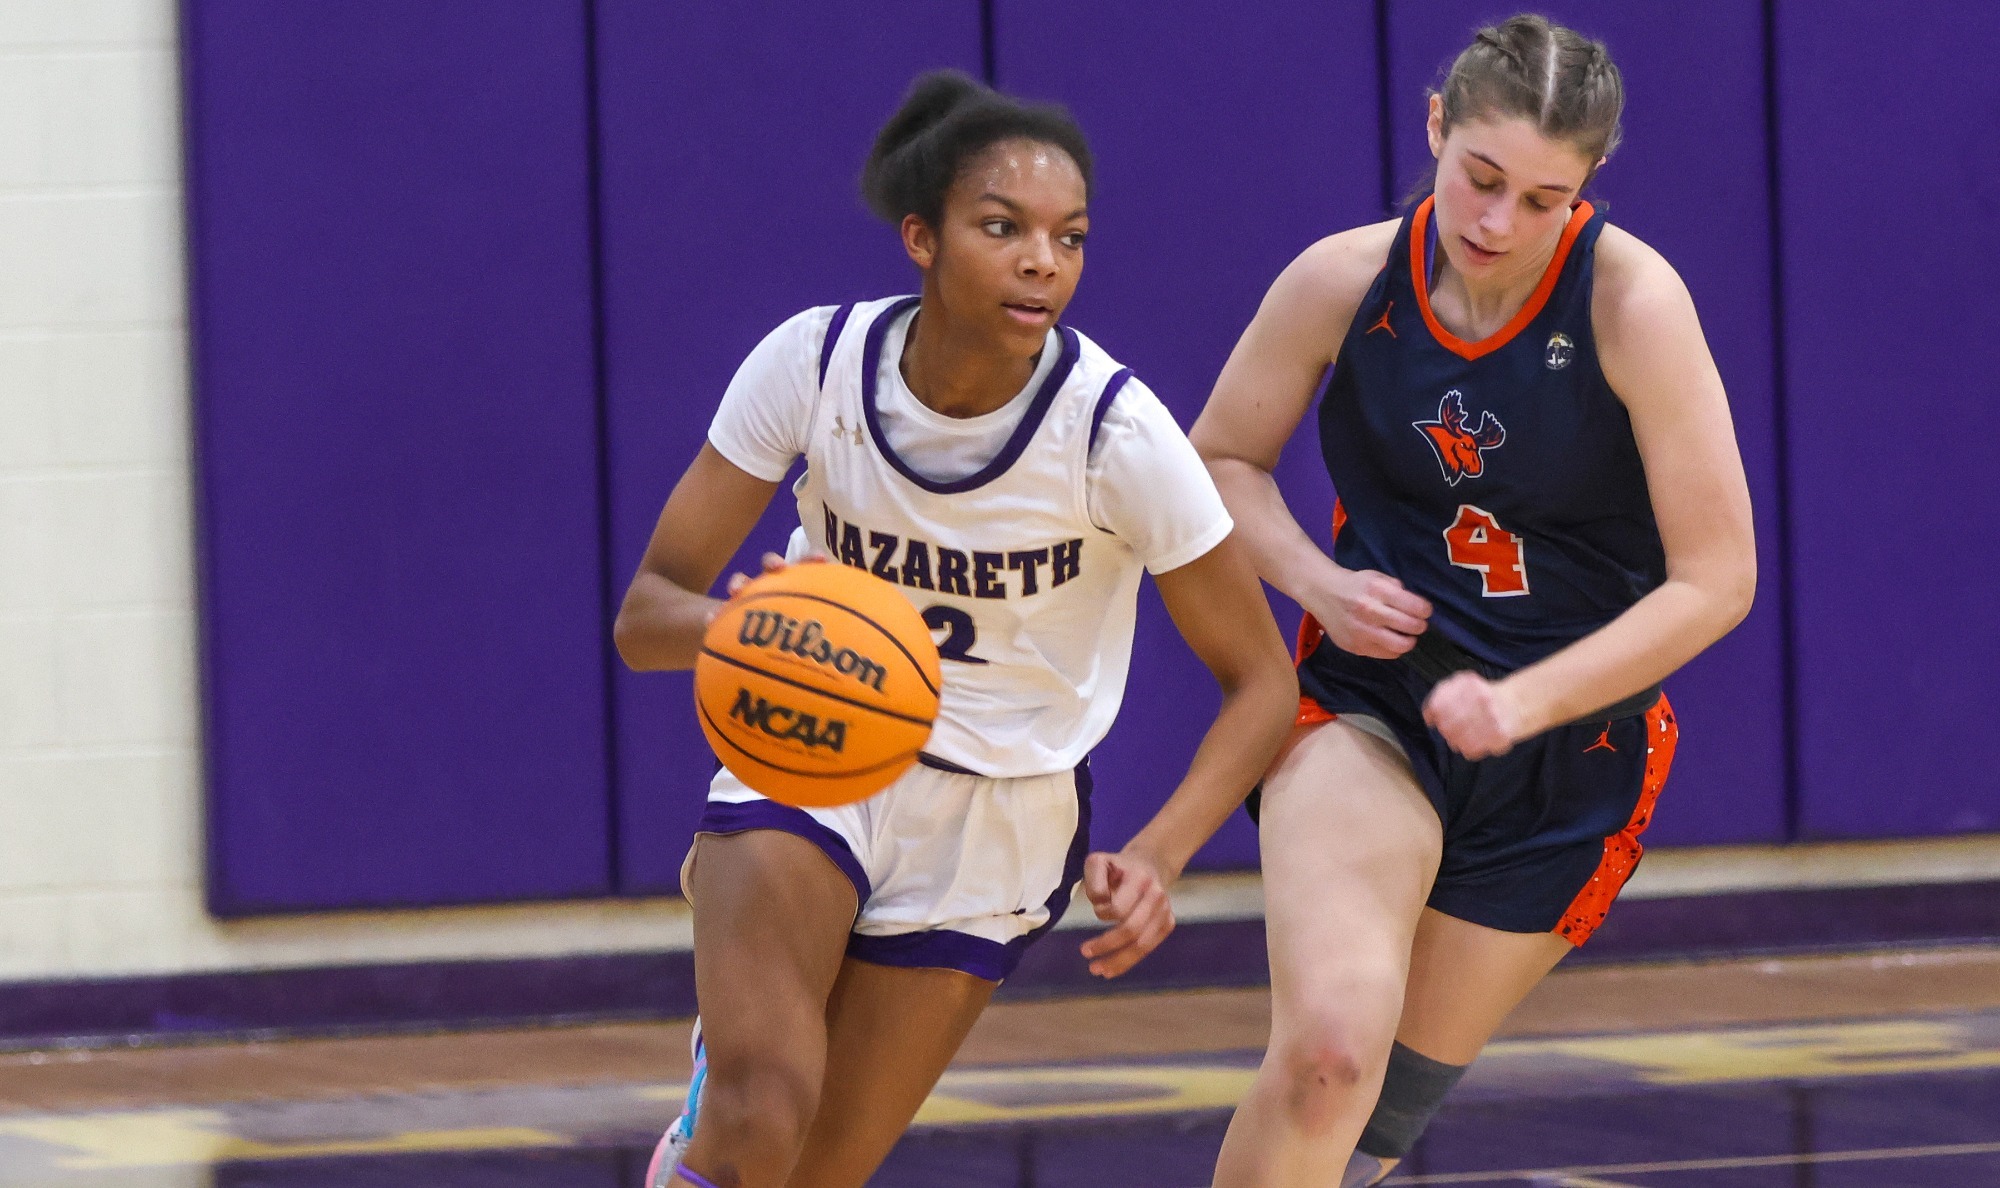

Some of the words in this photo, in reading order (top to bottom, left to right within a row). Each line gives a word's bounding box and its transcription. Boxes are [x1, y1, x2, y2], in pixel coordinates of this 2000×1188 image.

[822, 499, 1084, 600] NAZARETH
[1443, 504, 1530, 597] 4
[738, 610, 888, 692] Wilson
[920, 605, 989, 665] 2
[729, 687, 847, 753] NCAA
